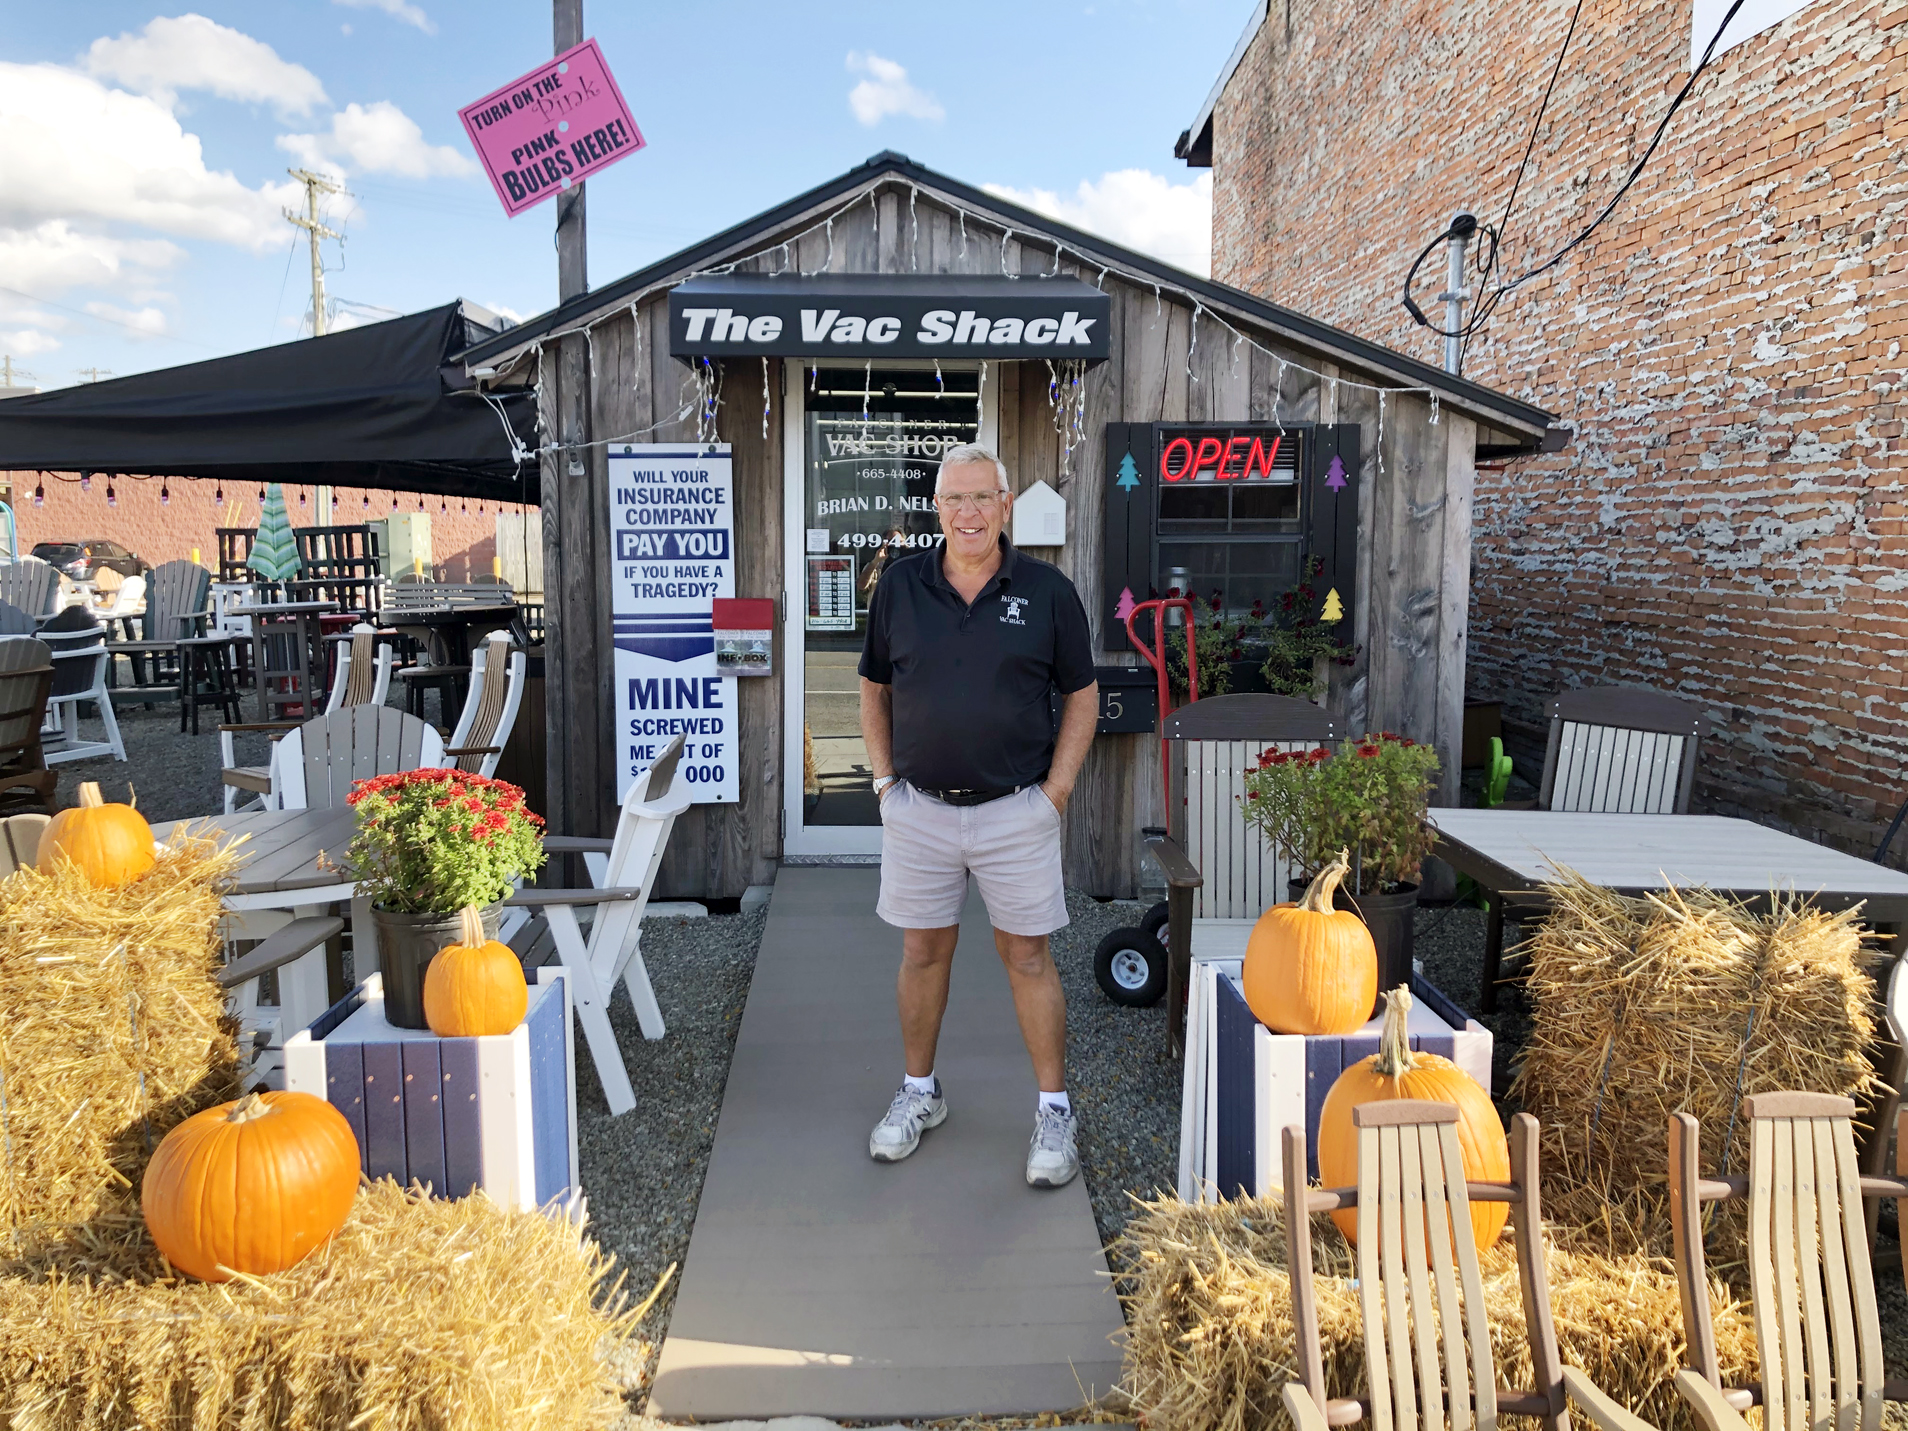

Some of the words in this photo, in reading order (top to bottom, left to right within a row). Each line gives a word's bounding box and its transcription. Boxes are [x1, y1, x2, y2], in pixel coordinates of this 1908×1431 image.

[471, 101, 512, 131] TURN
[512, 87, 535, 110] ON
[533, 72, 563, 98] THE
[531, 76, 602, 125] Pink
[511, 129, 560, 166] PINK
[502, 149, 574, 203] BULBS
[570, 118, 630, 168] HERE!
[681, 308, 783, 343] The
[800, 309, 901, 344] Vac
[916, 309, 1098, 345] Shack
[826, 433, 876, 456] VAC
[885, 433, 958, 457] SHOP
[1161, 436, 1281, 482] OPEN
[633, 470, 667, 484] WILL
[671, 470, 709, 484] YOUR
[617, 487, 725, 505] INSURANCE
[817, 496, 869, 516] BRIAN
[875, 496, 893, 510] D.
[899, 496, 944, 513] NELS
[625, 507, 718, 525] COMPANY
[622, 533, 668, 556] PAY
[674, 532, 724, 556] YOU
[837, 533, 945, 549] 499-4407
[624, 566, 637, 579] IF
[641, 566, 669, 579] YOU
[674, 565, 709, 578] HAVE
[714, 565, 724, 578] A
[631, 582, 719, 599] TRAGEDY?
[1001, 595, 1029, 606] FALCONER
[999, 615, 1008, 623] VAC
[628, 676, 724, 711] MINE
[630, 717, 724, 736] SCREWED
[630, 744, 656, 760] ME
[701, 743, 724, 759] OF
